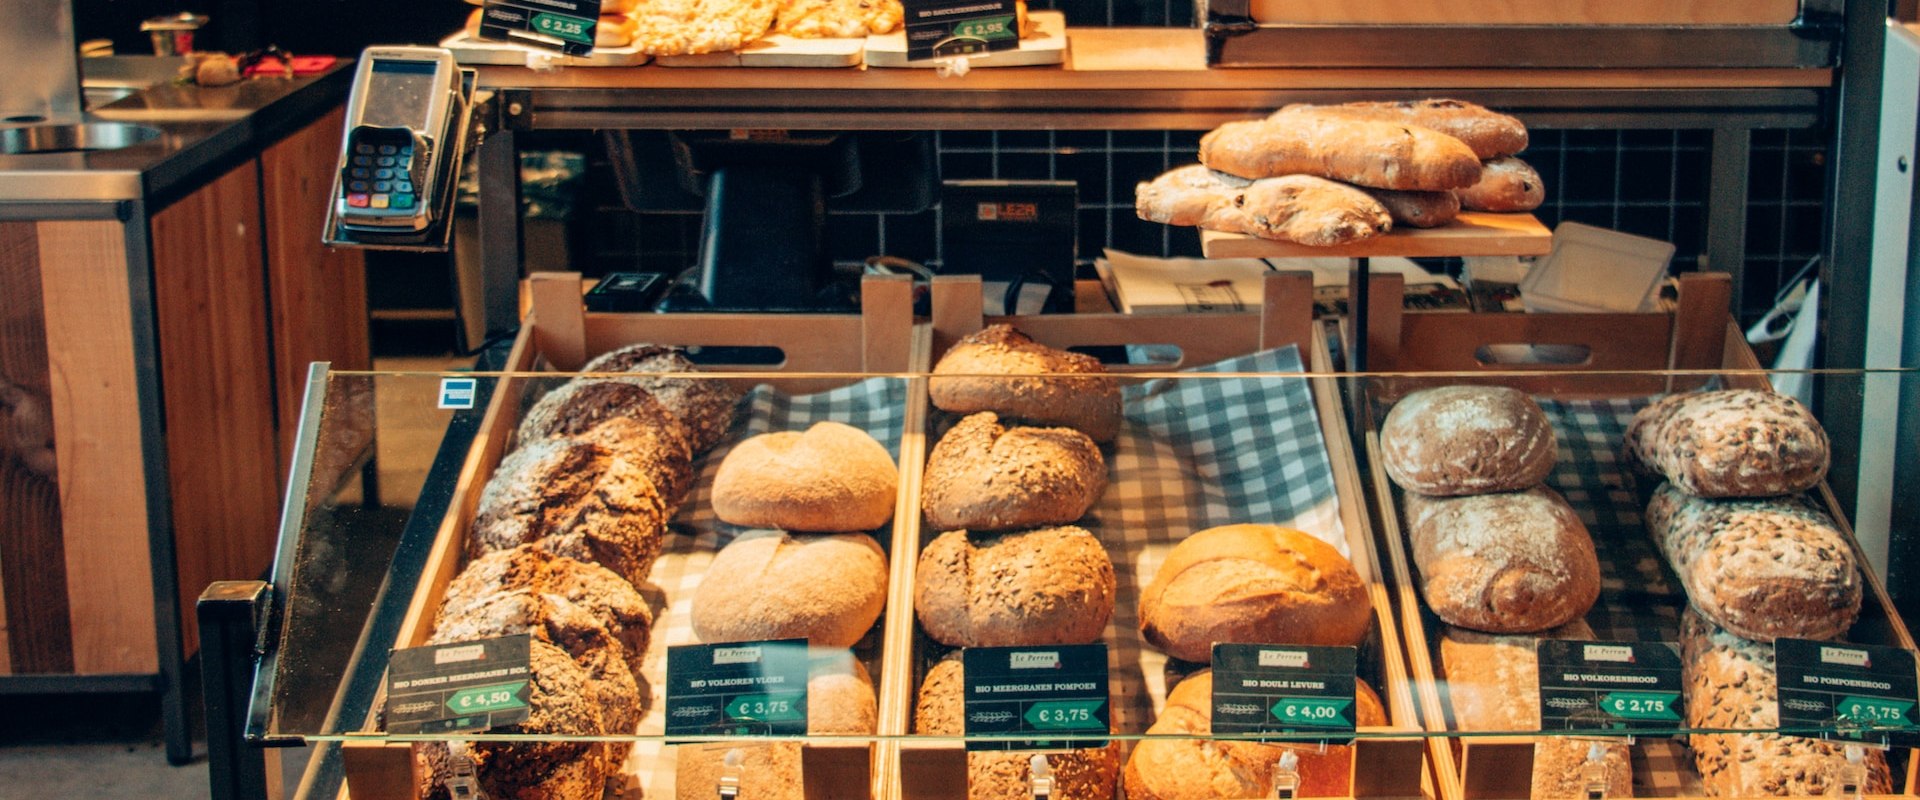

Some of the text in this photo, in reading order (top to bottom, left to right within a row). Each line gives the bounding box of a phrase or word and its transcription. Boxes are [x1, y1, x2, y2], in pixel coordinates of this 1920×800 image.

[541, 18, 582, 34] € 2,25
[976, 23, 1004, 35] 2,95
[1027, 654, 1054, 662] Perron
[393, 681, 410, 689] BIO
[411, 677, 447, 686] DONKER
[510, 666, 528, 675] BOL
[690, 676, 785, 688] BIO VOLKOREN VLOER
[1242, 680, 1325, 689] BIO BOULE LEVURE
[1563, 673, 1658, 684] BIO VOLKORENBROOD
[1803, 675, 1891, 689] BIO POMPOENBROOD
[975, 685, 991, 693] BIO
[992, 683, 1053, 692] MEERGRANEN
[460, 691, 511, 707] € 4,50
[1614, 699, 1665, 713] € 2,75
[739, 701, 789, 715] € 3,75
[1285, 705, 1336, 719] € 4,00
[1039, 709, 1089, 723] € 3,75
